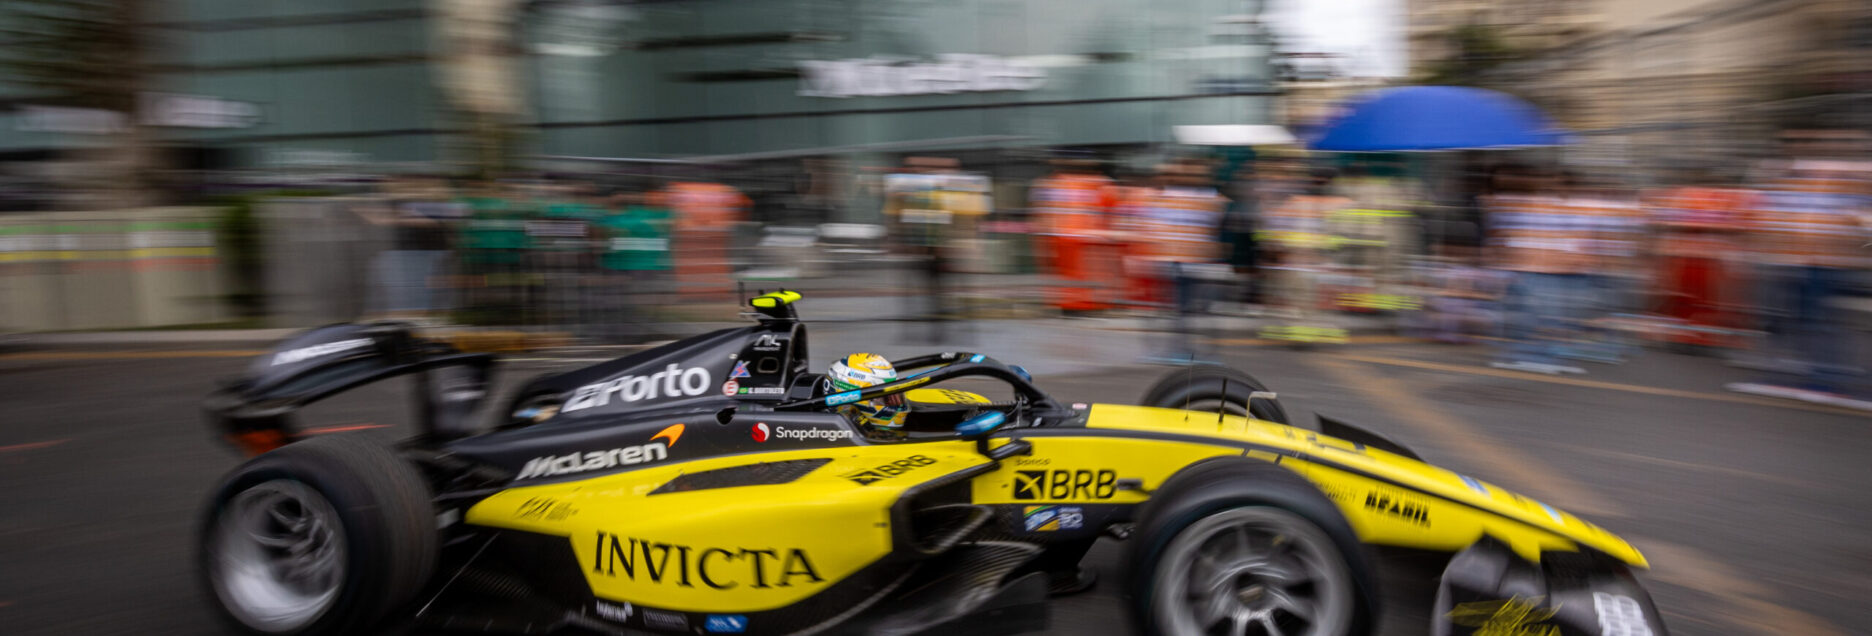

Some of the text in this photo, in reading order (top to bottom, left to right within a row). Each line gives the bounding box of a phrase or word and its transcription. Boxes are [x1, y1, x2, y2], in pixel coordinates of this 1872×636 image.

[776, 426, 853, 442] Snapdragon
[515, 442, 668, 481] McLaren
[876, 454, 938, 476] BRB
[1051, 469, 1117, 499] BRB
[593, 530, 827, 590] INVICTA
